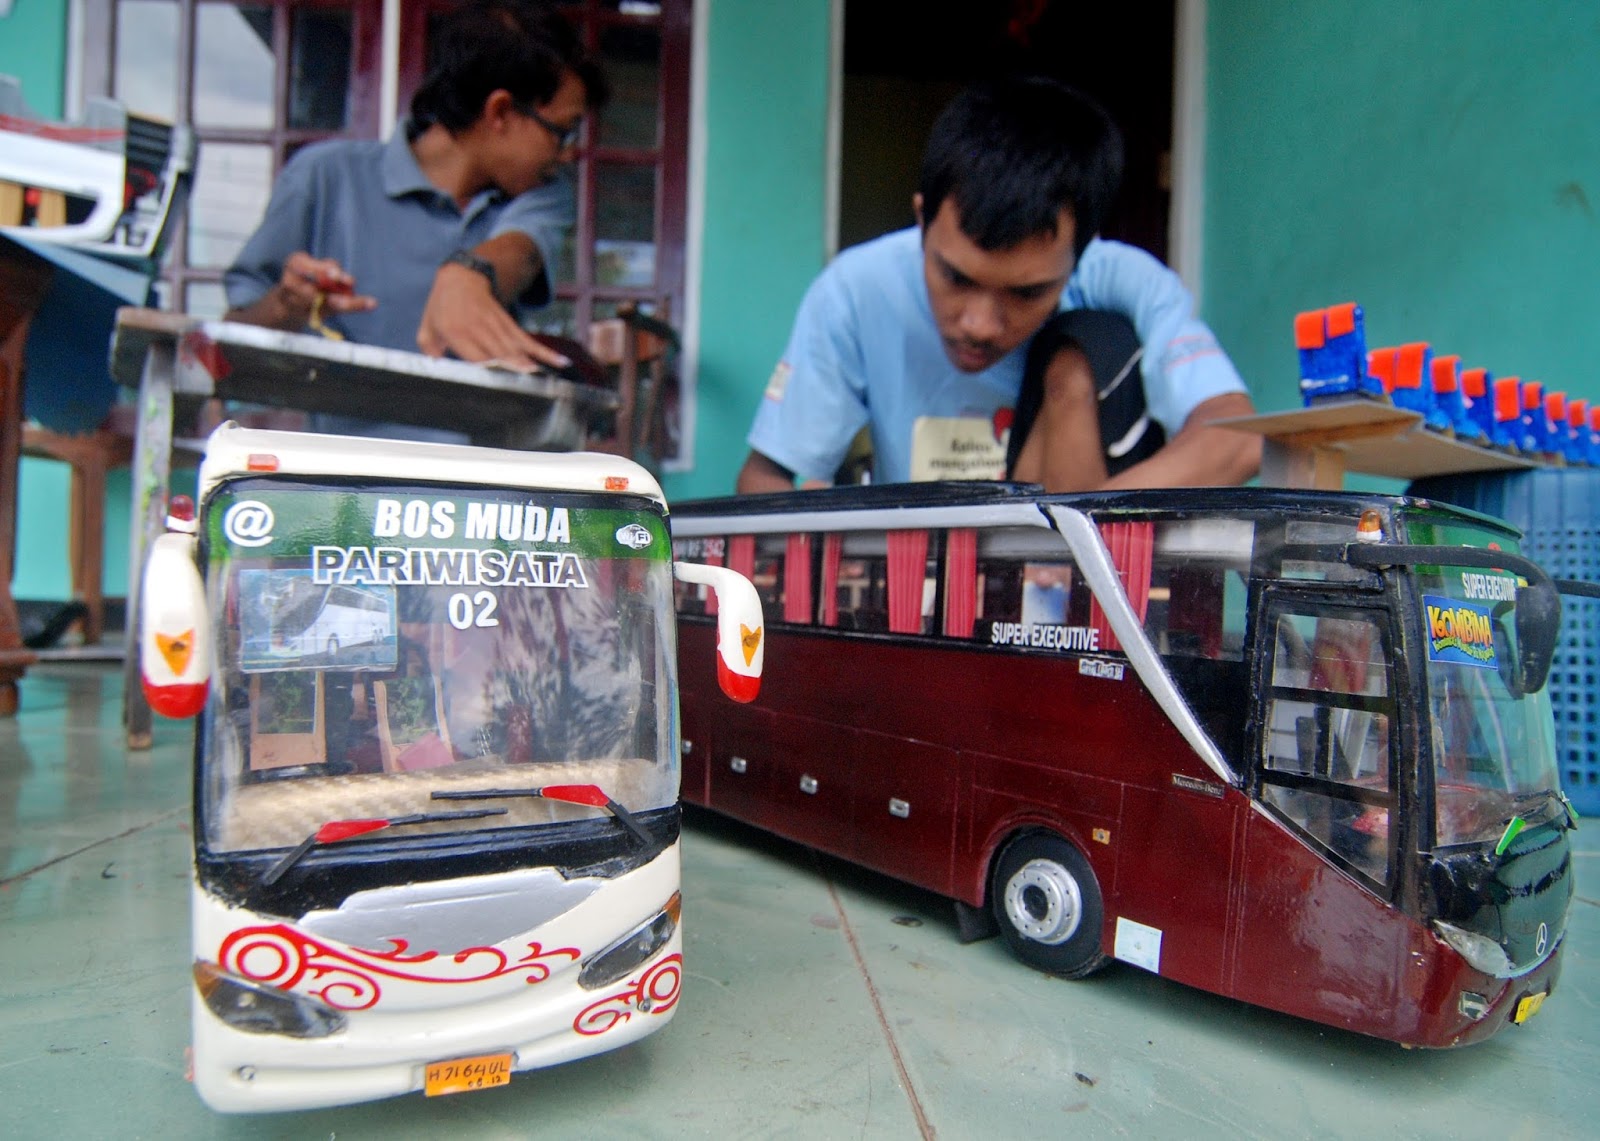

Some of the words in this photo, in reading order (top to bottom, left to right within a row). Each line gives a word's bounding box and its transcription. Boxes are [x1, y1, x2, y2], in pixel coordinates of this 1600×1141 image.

[224, 500, 275, 547] @
[373, 499, 456, 539] BOS
[465, 501, 570, 543] MUDA
[312, 546, 590, 589] PARIWISATA
[448, 590, 500, 630] 02
[991, 621, 1029, 646] SUPER
[1031, 625, 1100, 651] EXECUTIVE
[429, 1070, 440, 1082] H
[489, 1061, 508, 1074] UL
